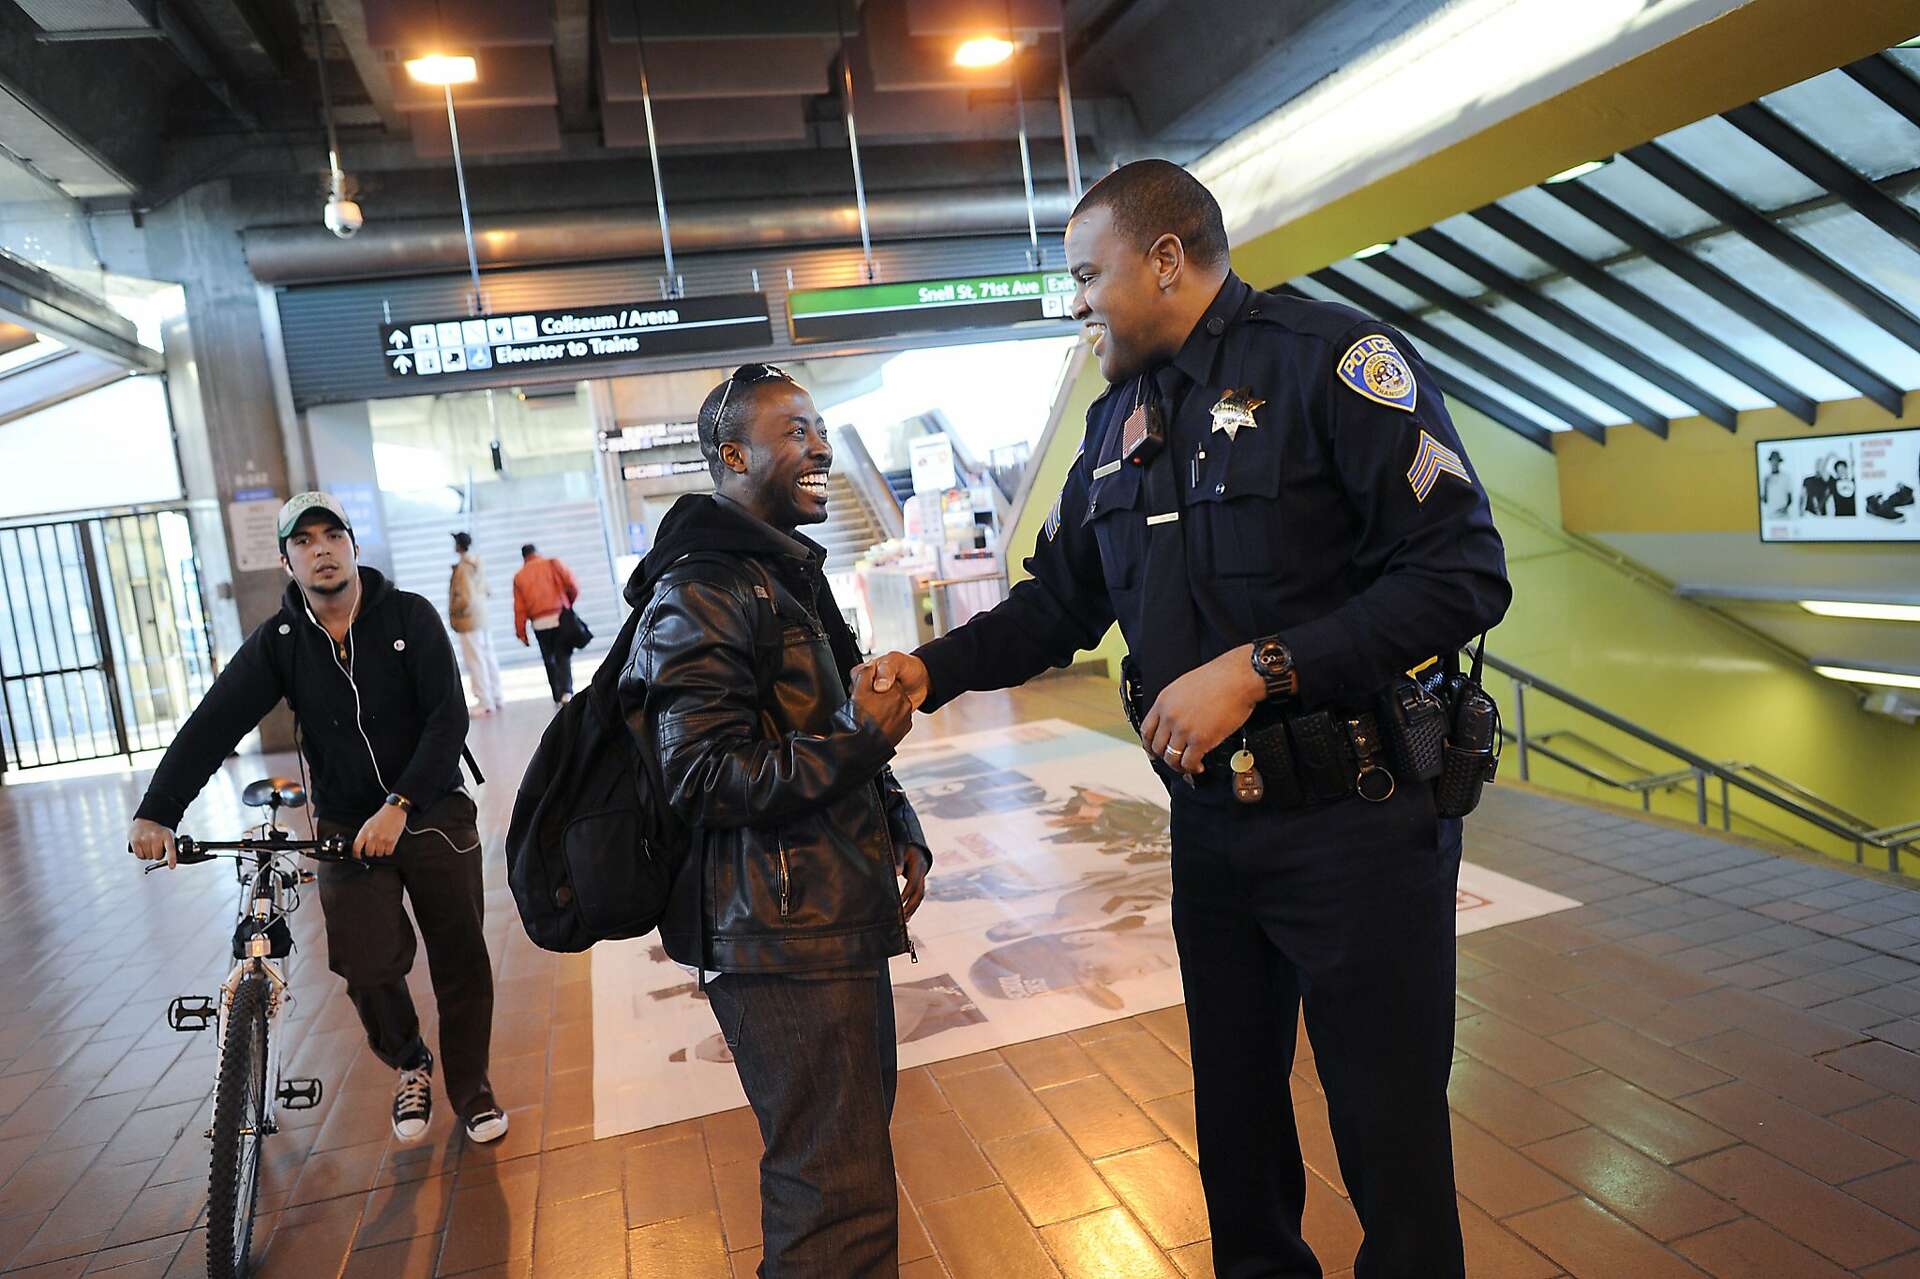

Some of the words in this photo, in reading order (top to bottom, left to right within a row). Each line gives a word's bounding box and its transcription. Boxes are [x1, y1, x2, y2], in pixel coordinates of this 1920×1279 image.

[918, 285, 955, 303] Snell
[979, 281, 1010, 298] 71st
[1011, 280, 1041, 295] Ave
[541, 315, 618, 335] Coliseum
[619, 310, 628, 329] /
[628, 309, 680, 328] Arena
[496, 343, 566, 364] Elevator
[567, 341, 588, 357] to
[589, 335, 640, 355] Trains
[1343, 339, 1397, 378] POLICE
